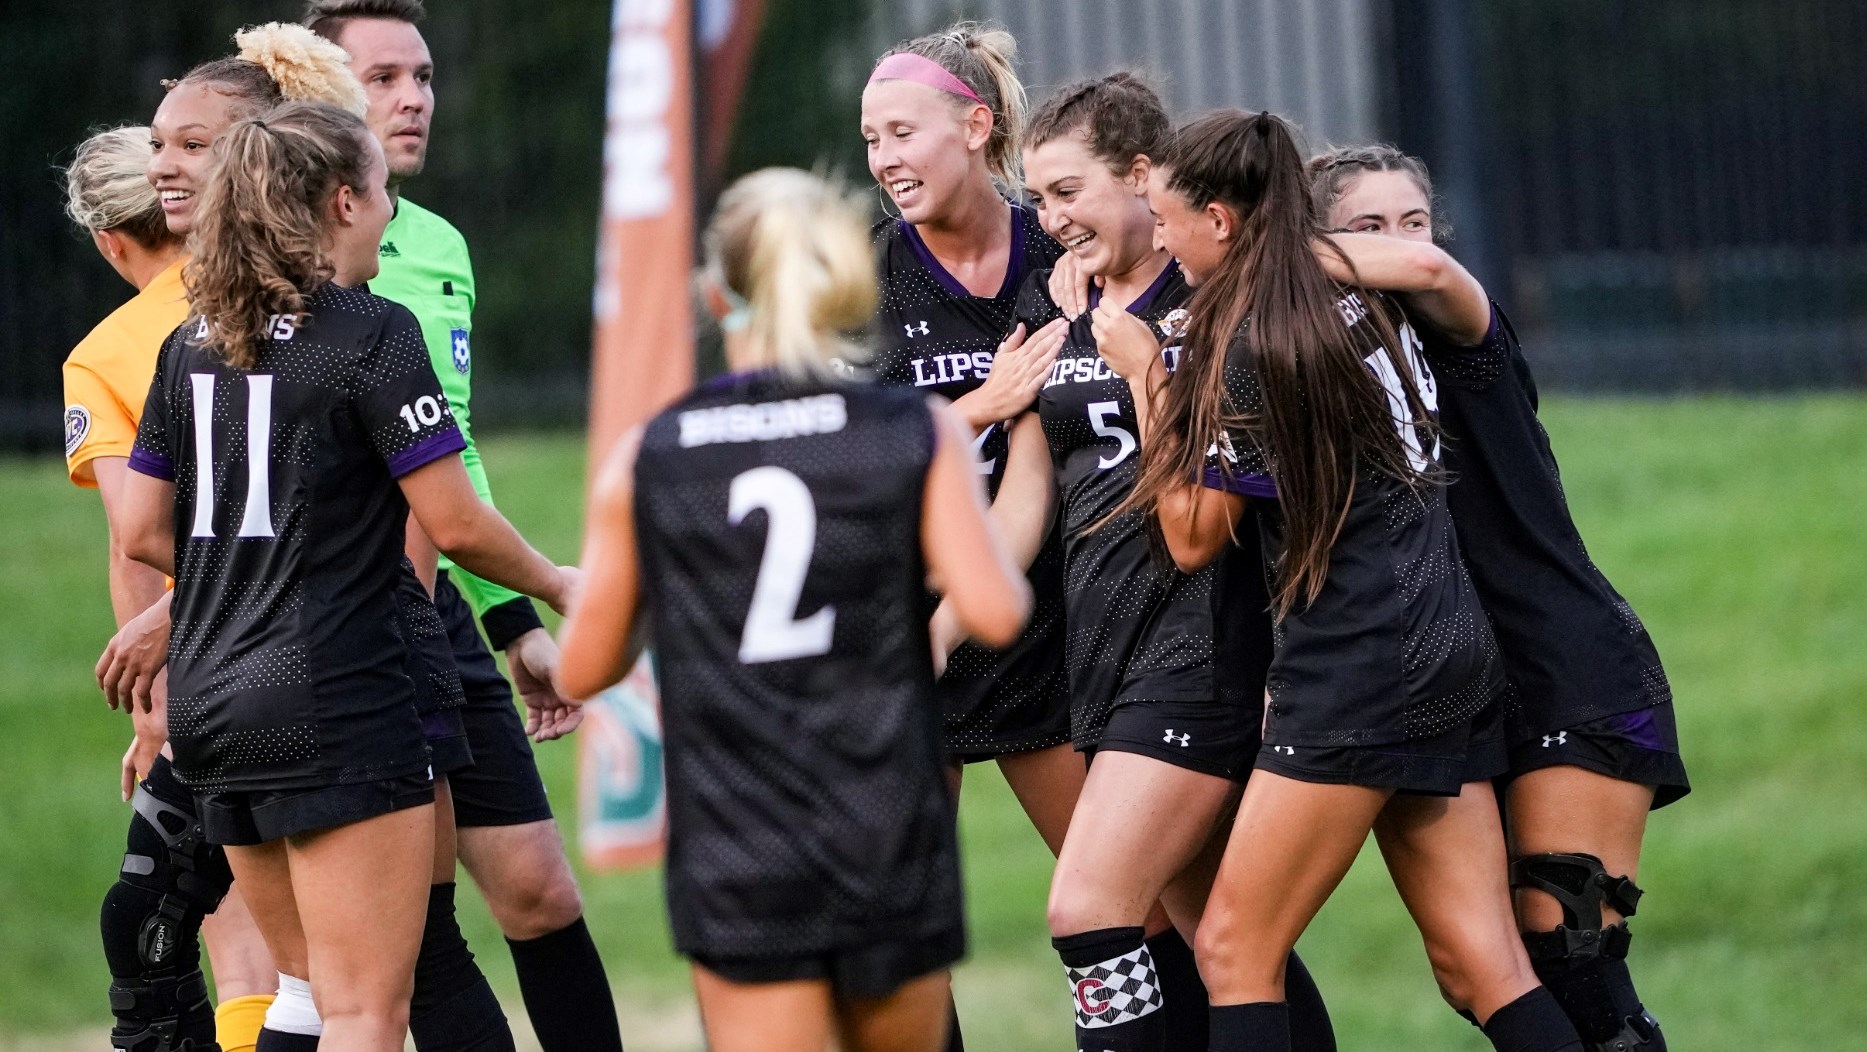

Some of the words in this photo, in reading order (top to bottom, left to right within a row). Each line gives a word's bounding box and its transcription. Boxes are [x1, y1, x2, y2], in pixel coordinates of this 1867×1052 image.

[911, 351, 993, 387] LIPS
[678, 393, 848, 449] BISONS
[1087, 400, 1136, 469] 5
[189, 373, 276, 538] 11
[728, 466, 836, 664] 2
[154, 924, 166, 962] FUSION
[1076, 977, 1111, 1015] C
